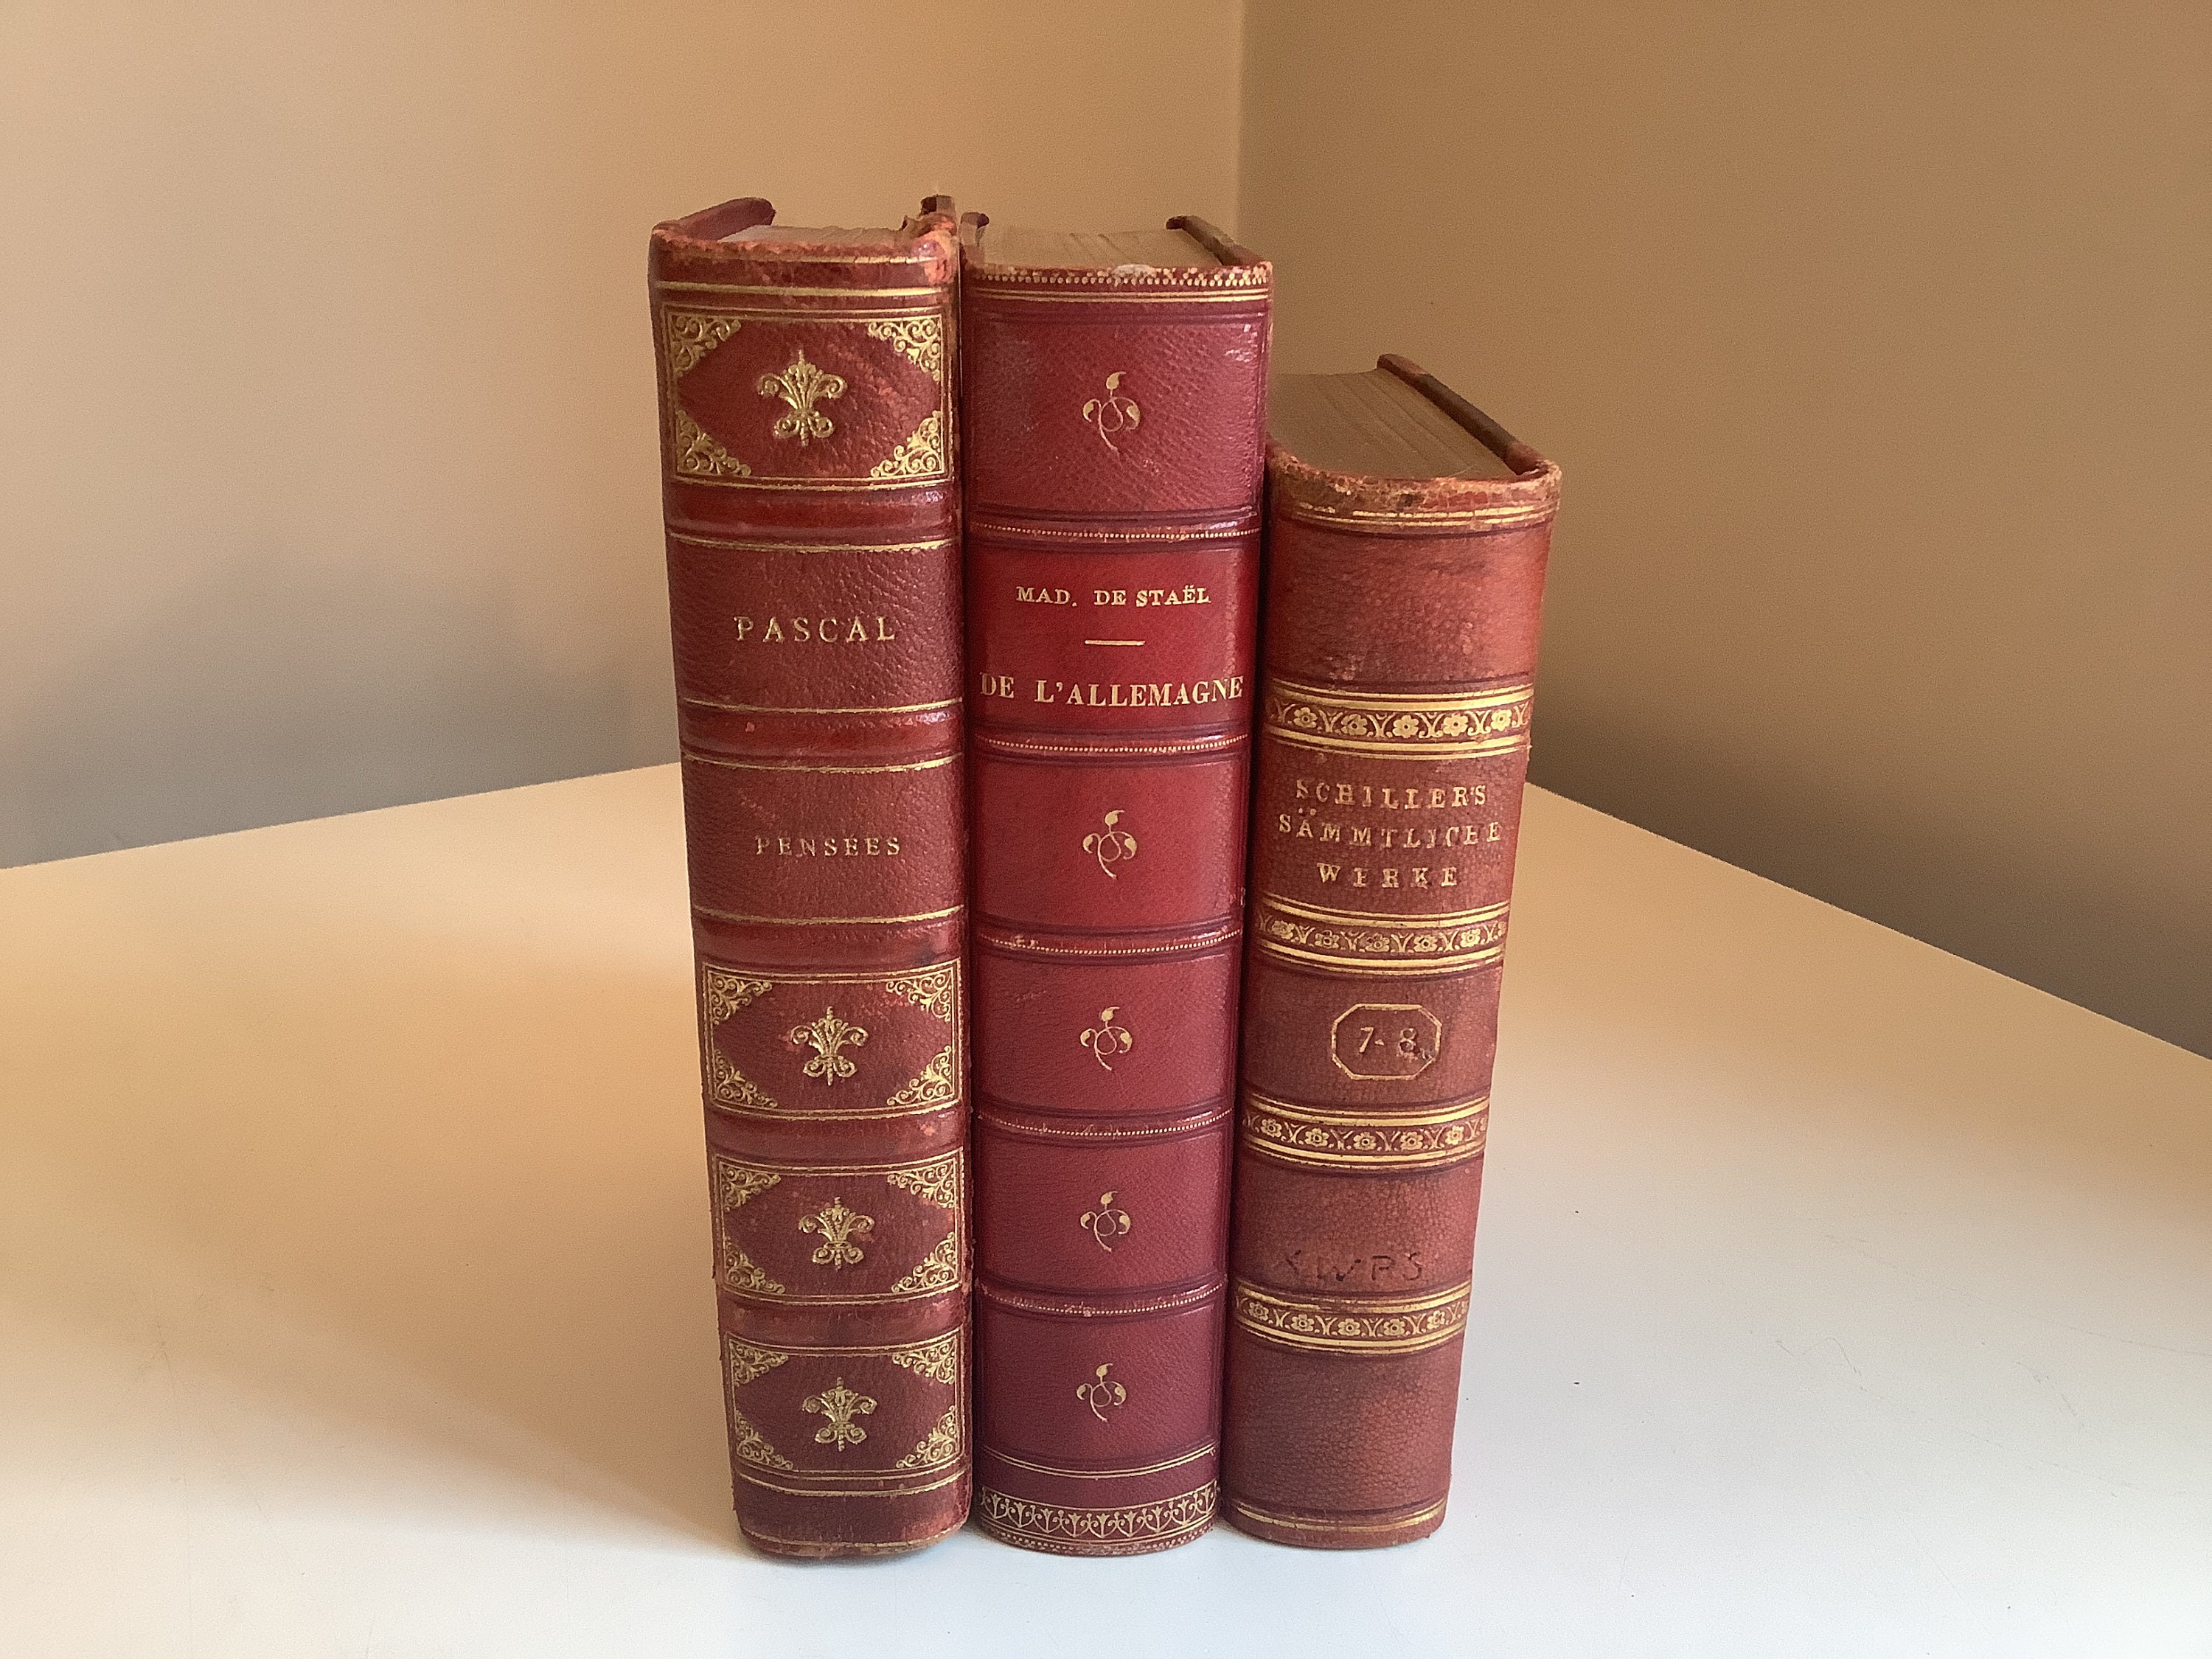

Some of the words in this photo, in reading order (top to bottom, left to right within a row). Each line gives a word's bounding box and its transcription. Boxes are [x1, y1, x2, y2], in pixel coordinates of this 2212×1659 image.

[1015, 586, 1077, 606] MAD.
[1094, 590, 1126, 605] DE
[1135, 585, 1211, 607] STAËL
[734, 616, 895, 642] PASCAL
[980, 672, 1015, 699] DE
[1034, 676, 1244, 707] L'ALLEMAGNE
[1279, 807, 1501, 849] SÄMMTLICHE
[1317, 862, 1458, 890] WERKE
